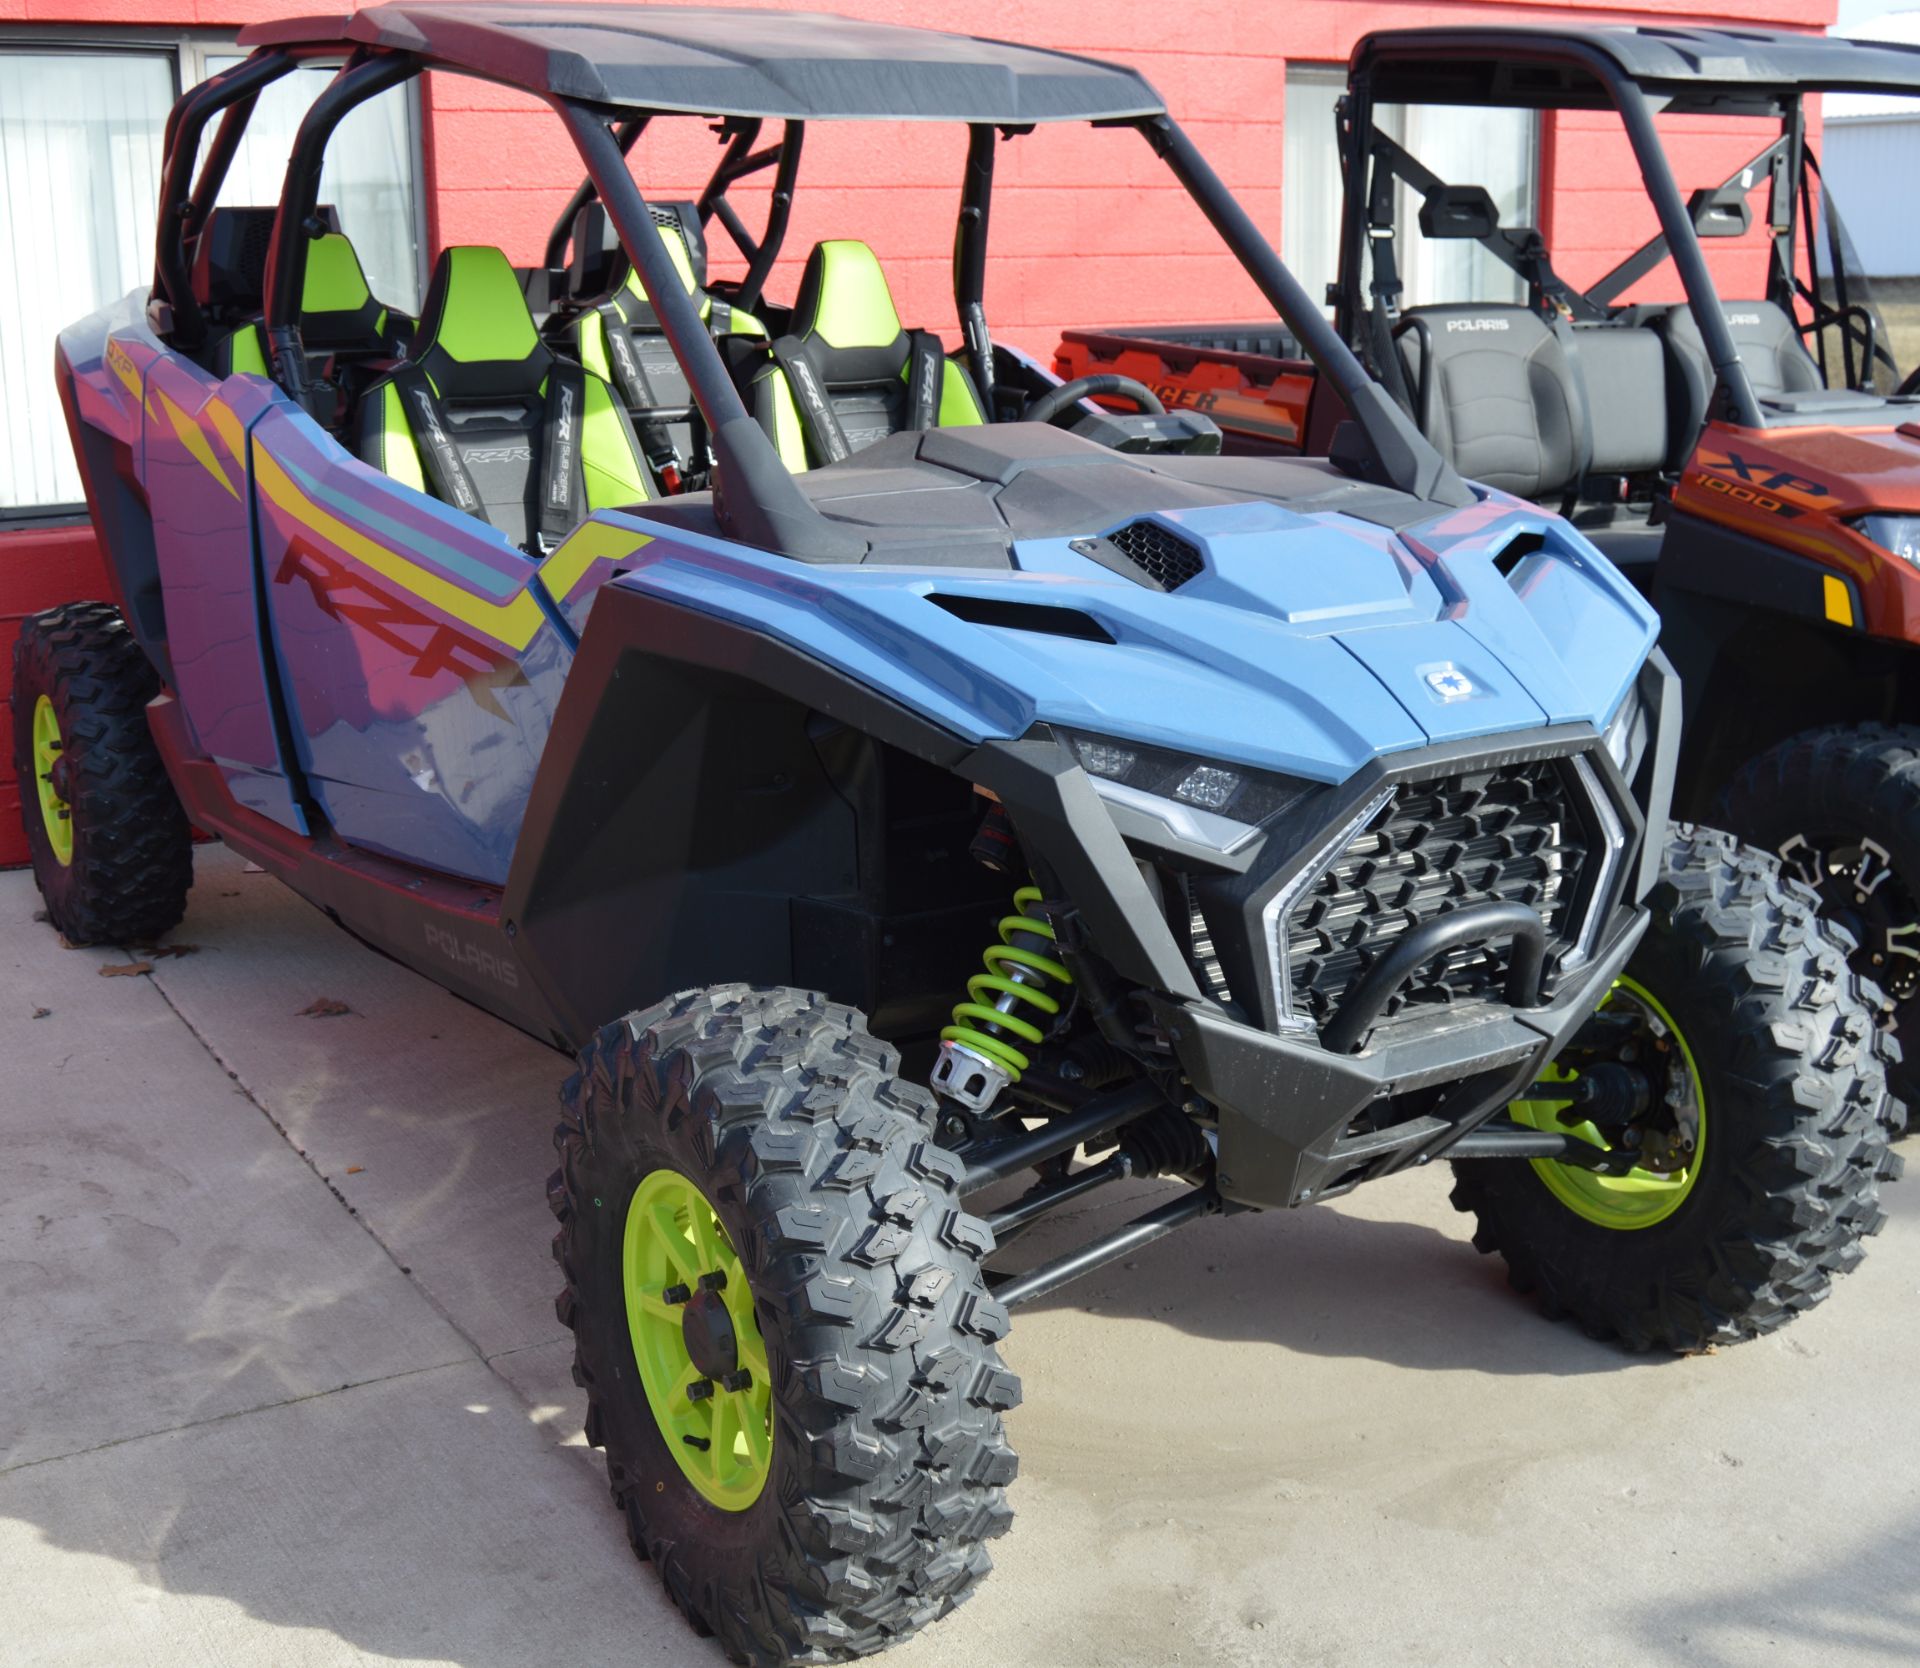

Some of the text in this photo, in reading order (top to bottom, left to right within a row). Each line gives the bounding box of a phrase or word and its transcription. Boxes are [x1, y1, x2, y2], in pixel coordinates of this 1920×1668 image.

[1446, 318, 1510, 332] POLARIS
[612, 332, 636, 377] RZR
[922, 353, 935, 404] RZR
[793, 360, 824, 409] RZR
[413, 389, 446, 443] RZR
[463, 446, 534, 464] RZR
[558, 385, 573, 505] RZR SUB ZERO
[1696, 472, 1783, 512] 1000
[1704, 451, 1829, 496] XP
[274, 533, 531, 726] RZR
[423, 922, 519, 988] POLARIS
